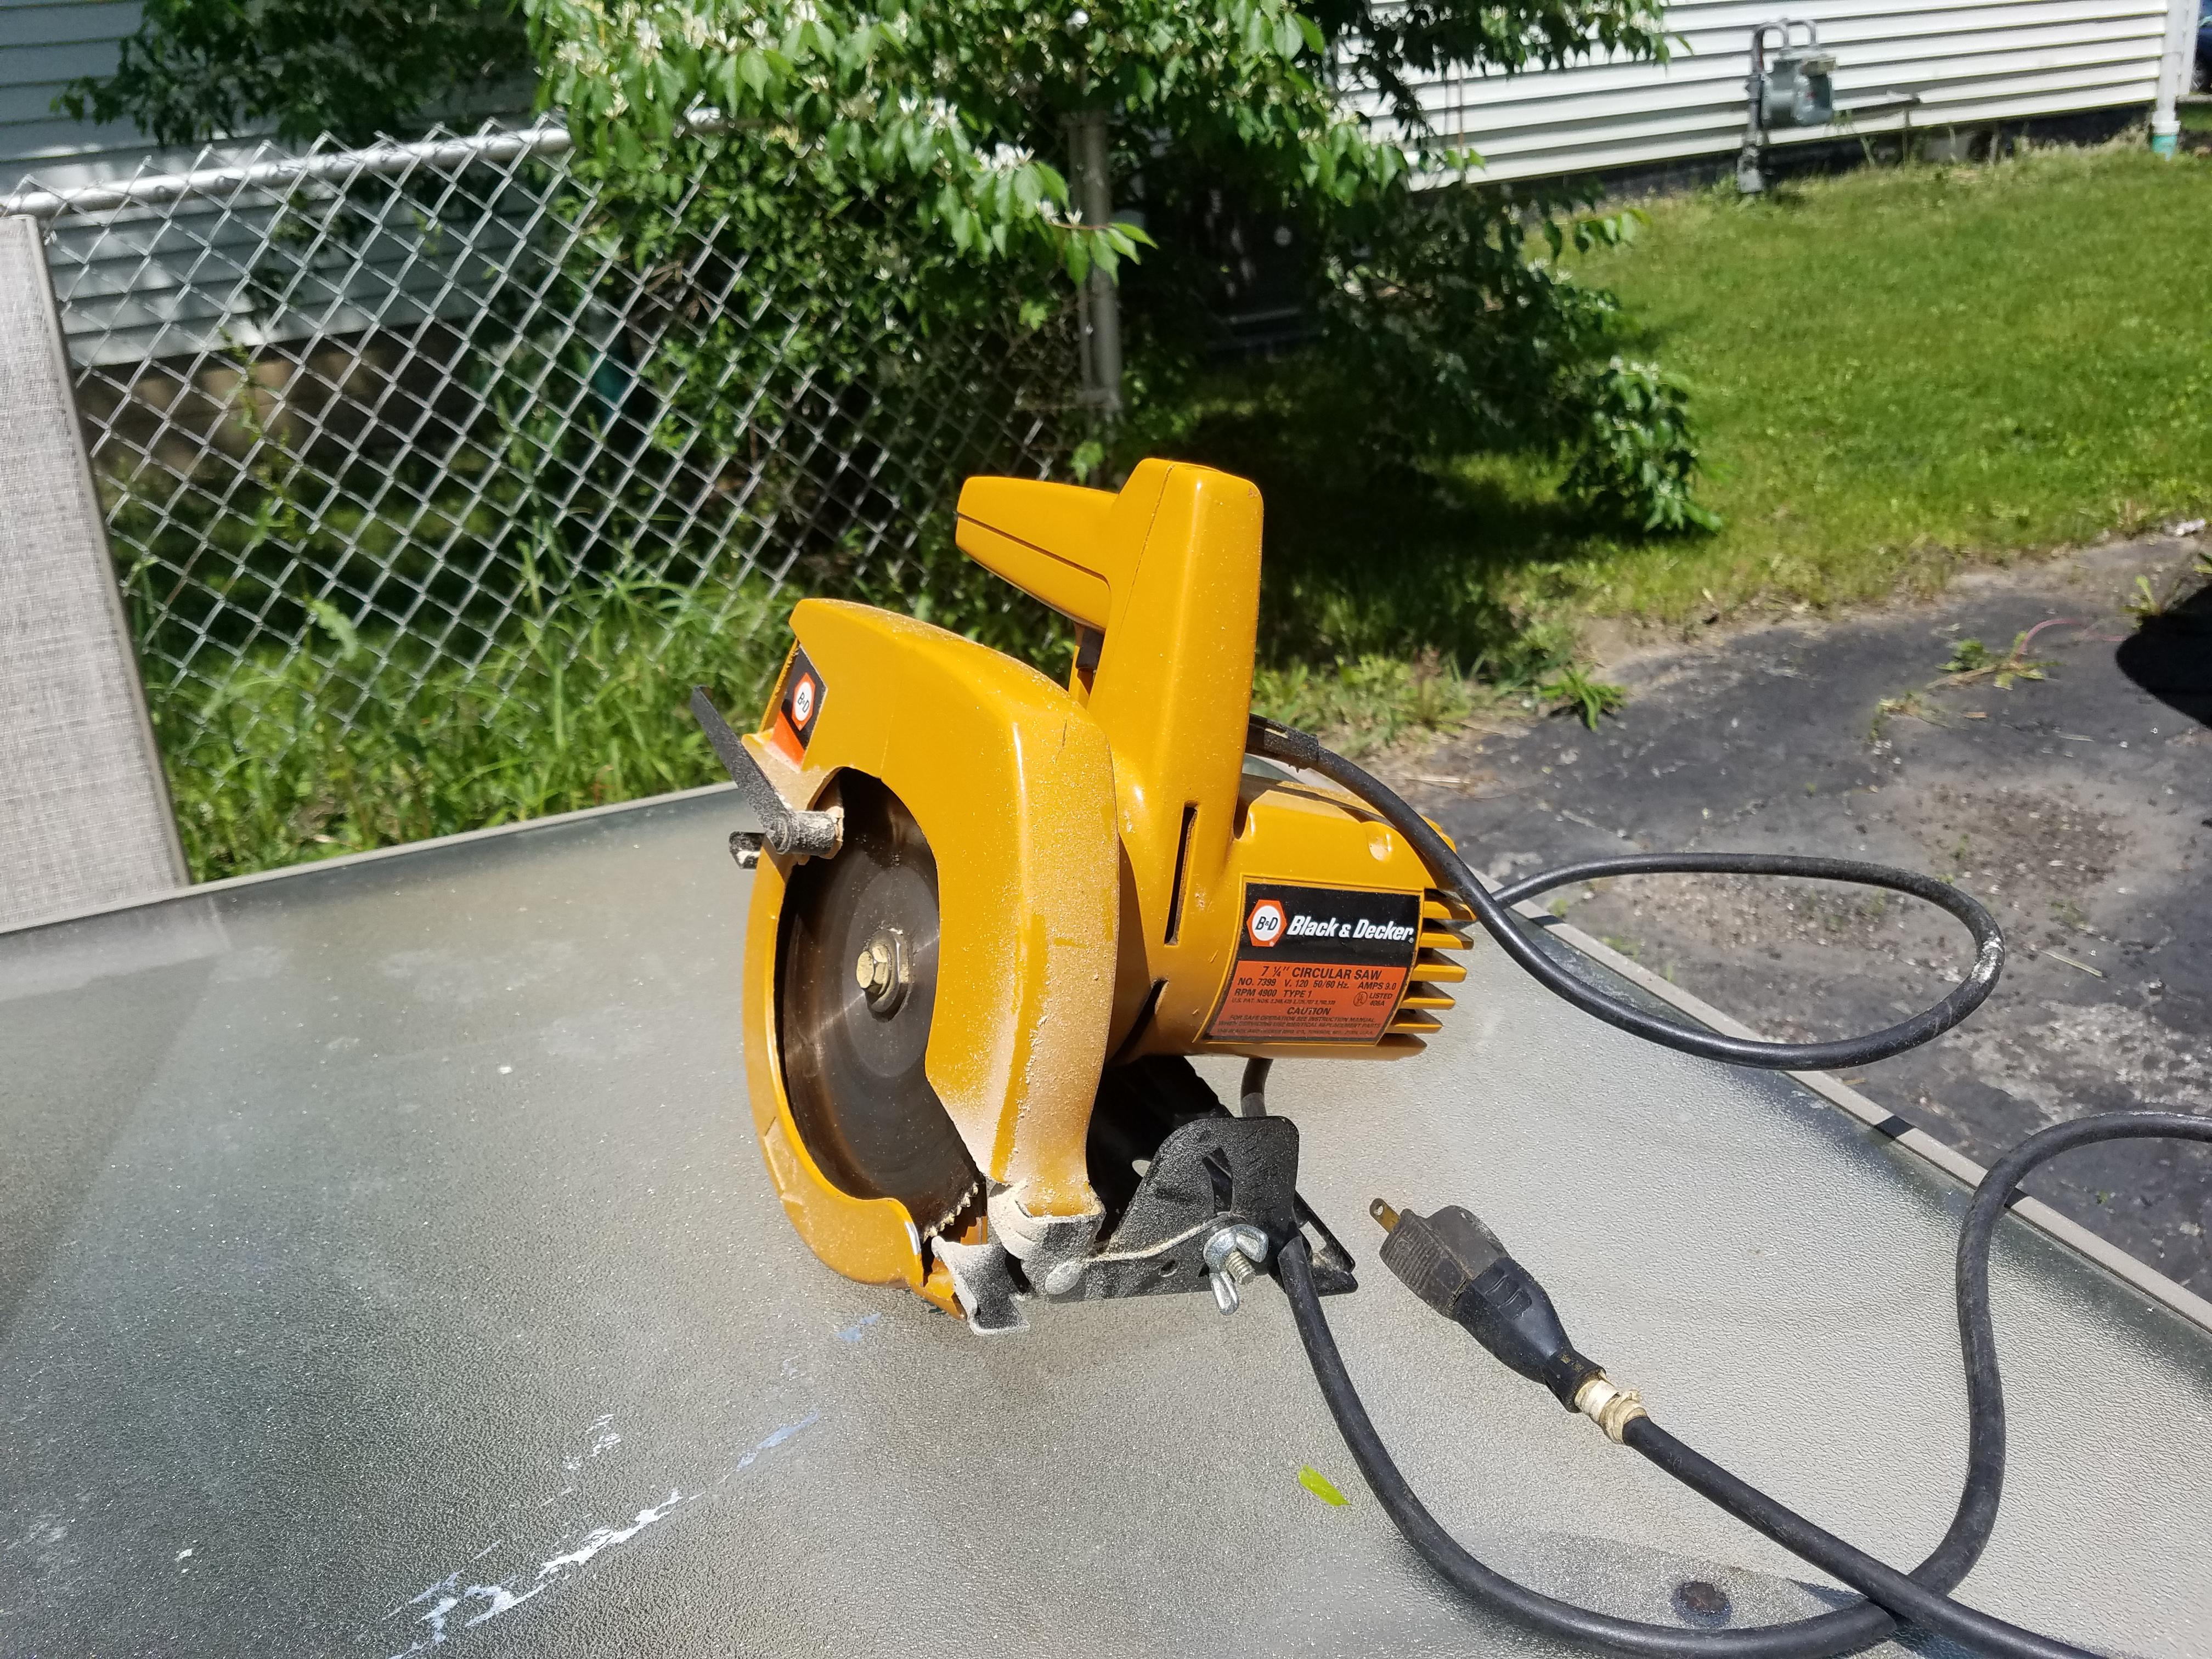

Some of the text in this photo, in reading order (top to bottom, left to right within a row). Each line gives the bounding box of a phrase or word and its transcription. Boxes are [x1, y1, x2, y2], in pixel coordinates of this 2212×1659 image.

[797, 691, 810, 713] B&D
[1255, 916, 1278, 931] B&D
[1286, 915, 1340, 937] Black
[1339, 924, 1350, 938] &
[1261, 966, 1269, 976] 7
[1291, 967, 1352, 980] CIRCULAR
[1354, 969, 1383, 980] SAW
[1237, 977, 1254, 986] NO.
[1257, 978, 1277, 986] 7399
[1284, 979, 1292, 988] V.
[1295, 979, 1309, 988] 120
[1313, 980, 1335, 988] 50/60
[1357, 981, 1384, 990] AMPS
[1234, 988, 1256, 996] RPM
[1286, 1006, 1331, 1015] CAUTION
